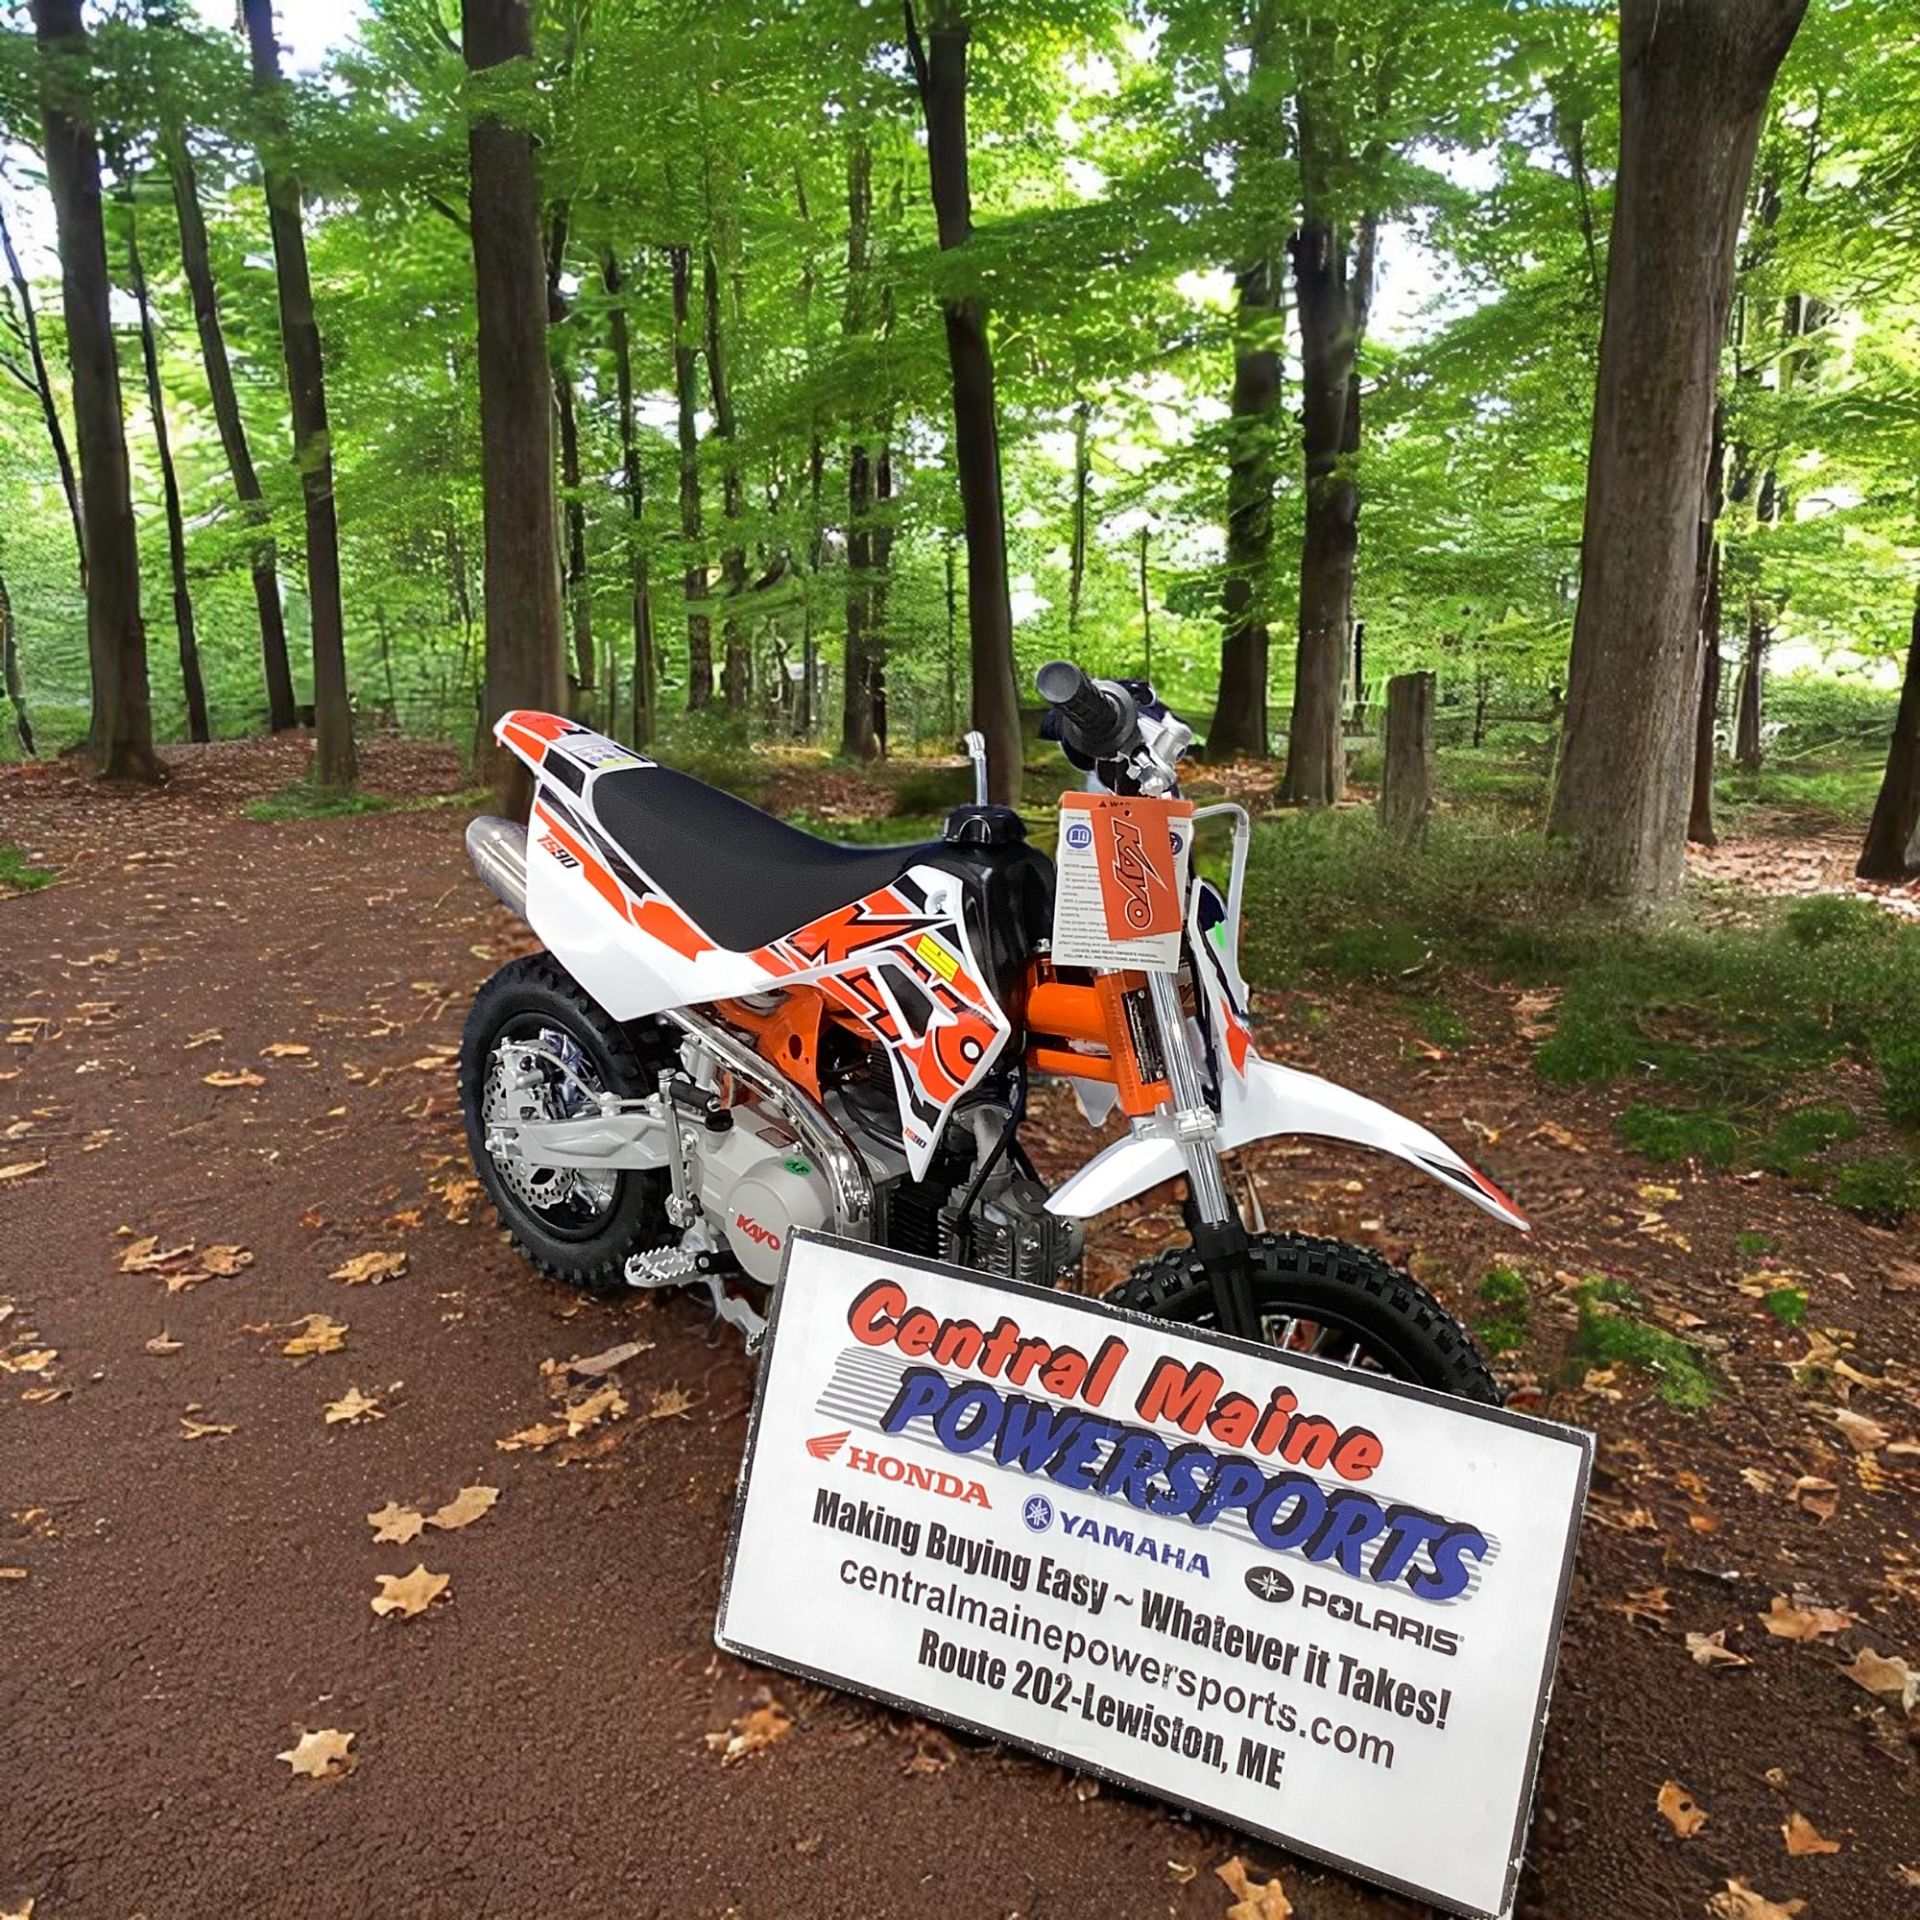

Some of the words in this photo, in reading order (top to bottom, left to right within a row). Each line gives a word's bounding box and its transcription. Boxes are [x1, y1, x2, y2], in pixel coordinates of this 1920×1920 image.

[1111, 816, 1169, 931] KAYO
[847, 1278, 1130, 1408] Central
[1134, 1355, 1384, 1481] Maine
[846, 1446, 993, 1510] HONDA
[879, 1366, 1489, 1600] POWERSPORTS
[1059, 1510, 1211, 1579] YAMAHA
[812, 1487, 922, 1557] Making
[925, 1521, 1032, 1592] Buying
[1036, 1555, 1109, 1615] Easy
[1140, 1588, 1300, 1676] Whatever
[1303, 1643, 1331, 1689] it
[1338, 1653, 1453, 1730] Takes!
[840, 1559, 1396, 1769] centralmainepowersports.com
[918, 1628, 1007, 1690] Route
[1011, 1660, 1229, 1774] 202-Lewiston,
[1236, 1736, 1286, 1790] ME
